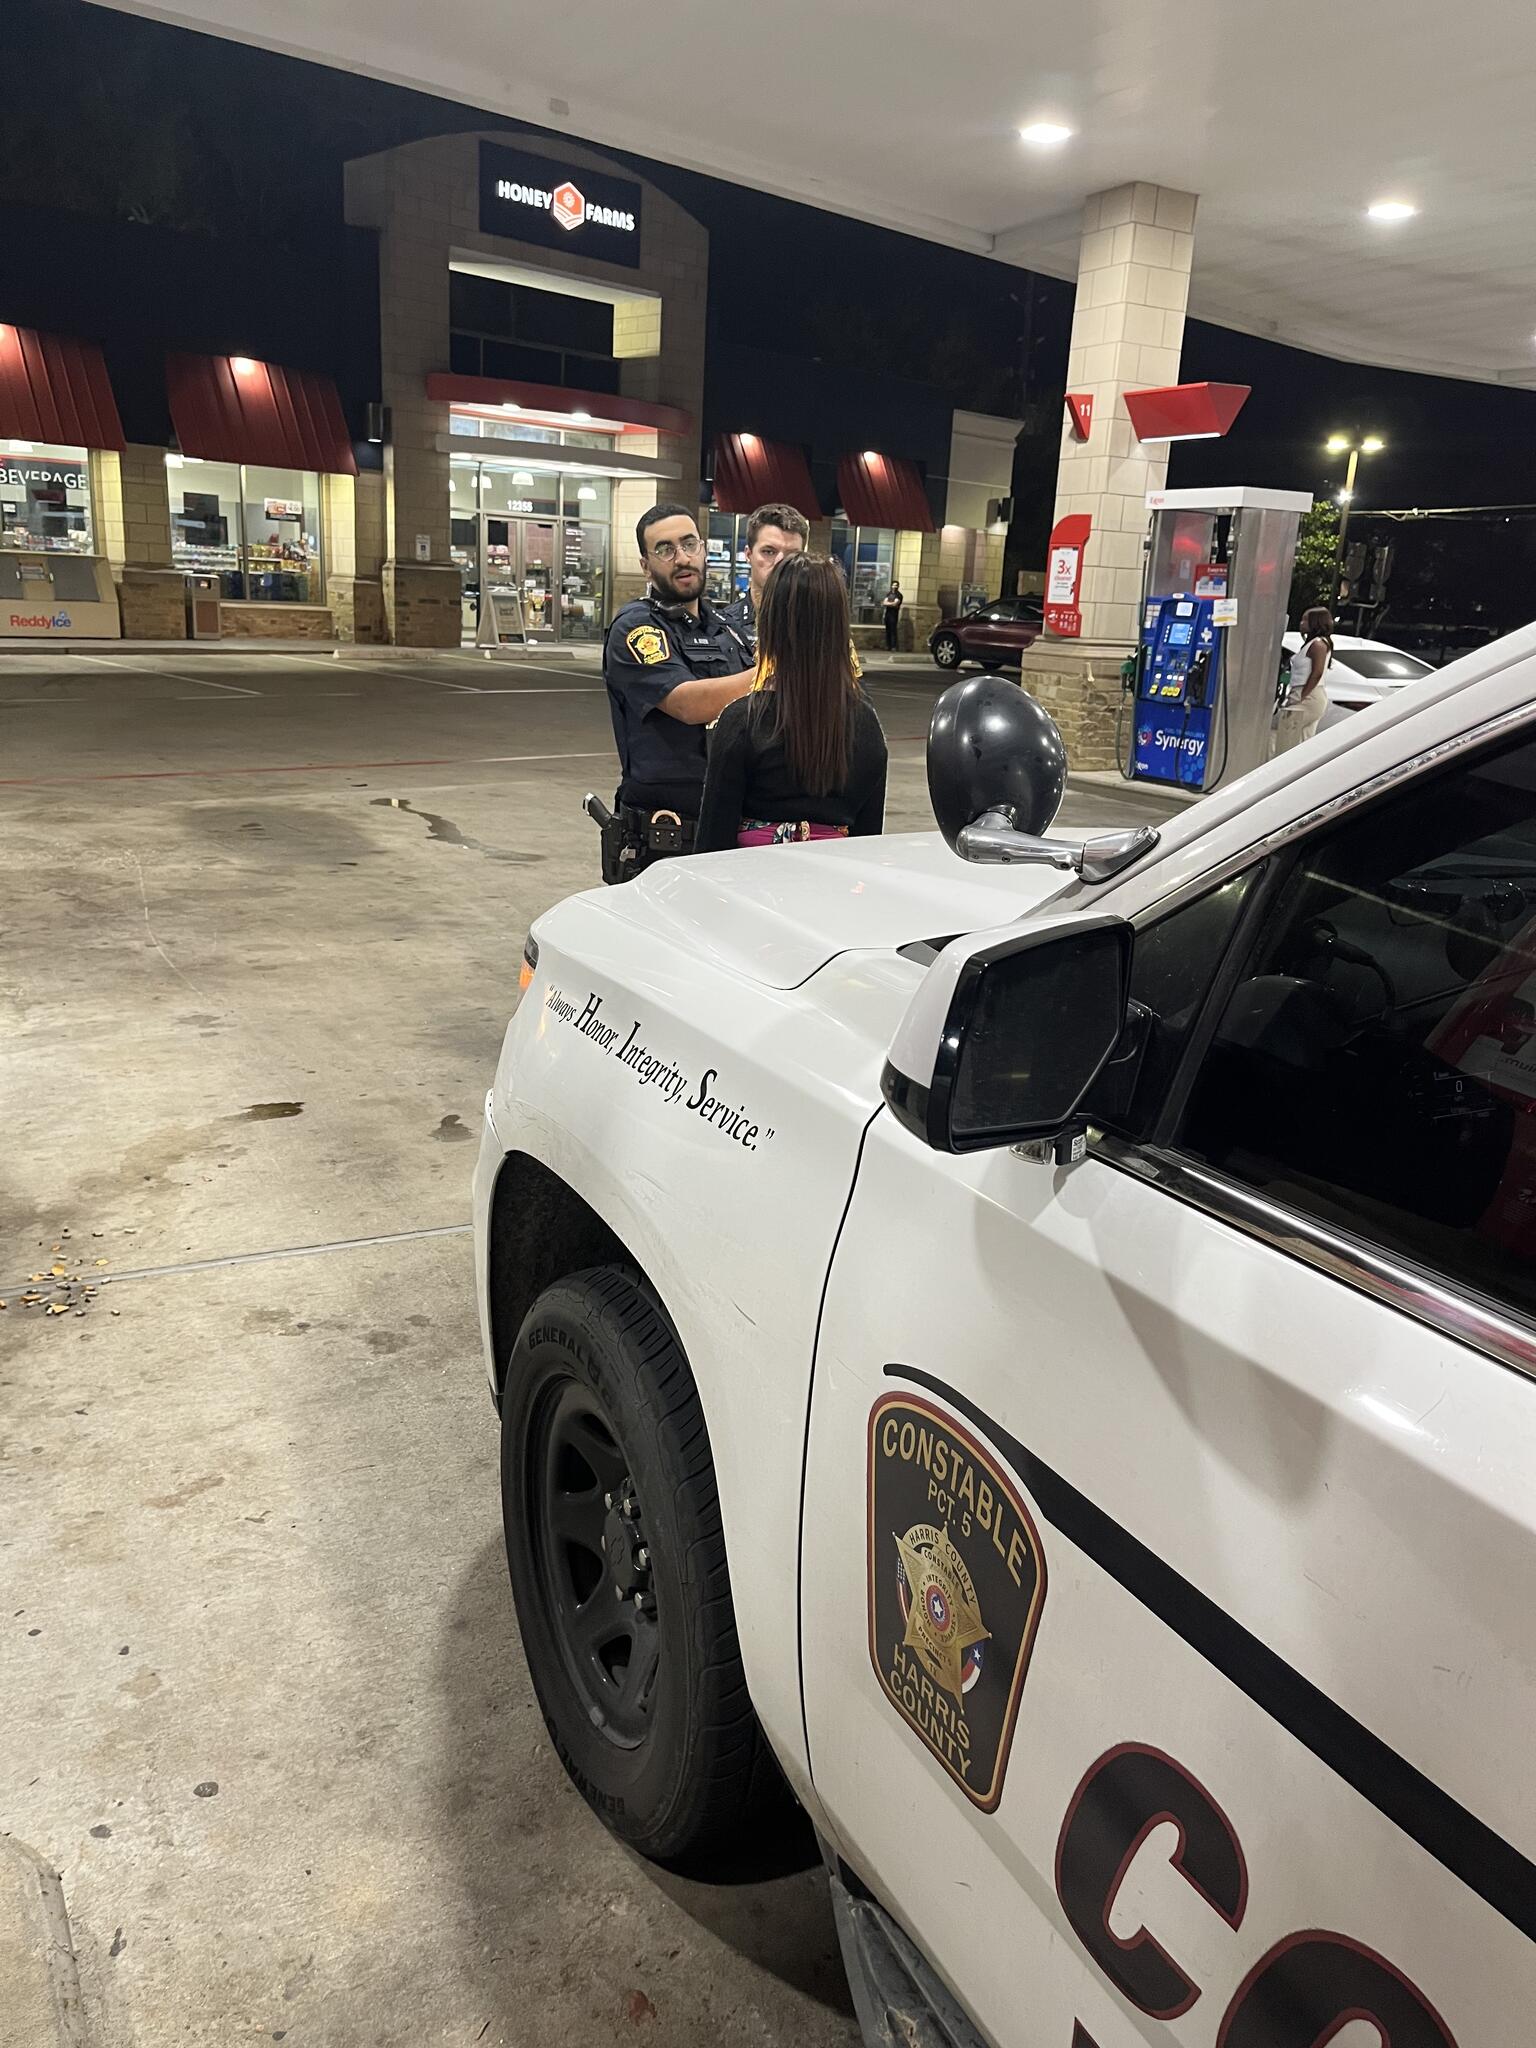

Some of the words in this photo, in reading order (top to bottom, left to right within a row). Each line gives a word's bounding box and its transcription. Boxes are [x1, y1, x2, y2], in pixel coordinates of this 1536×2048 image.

[498, 179, 553, 210] HONEY
[585, 202, 635, 231] FARMS
[1080, 403, 1091, 417] 11
[1057, 559, 1072, 576] 3x
[573, 992, 619, 1056] Honor,
[615, 1020, 688, 1104] Integrity,
[528, 1325, 585, 1366] GENERAL
[882, 1418, 1027, 1589] CONSTABLE
[961, 1511, 972, 1538] 5
[909, 1528, 939, 1545] HARRIS
[945, 1543, 977, 1605] COUNTY
[889, 1669, 972, 1777] COUNTY
[892, 1643, 971, 1750] HARRIS
